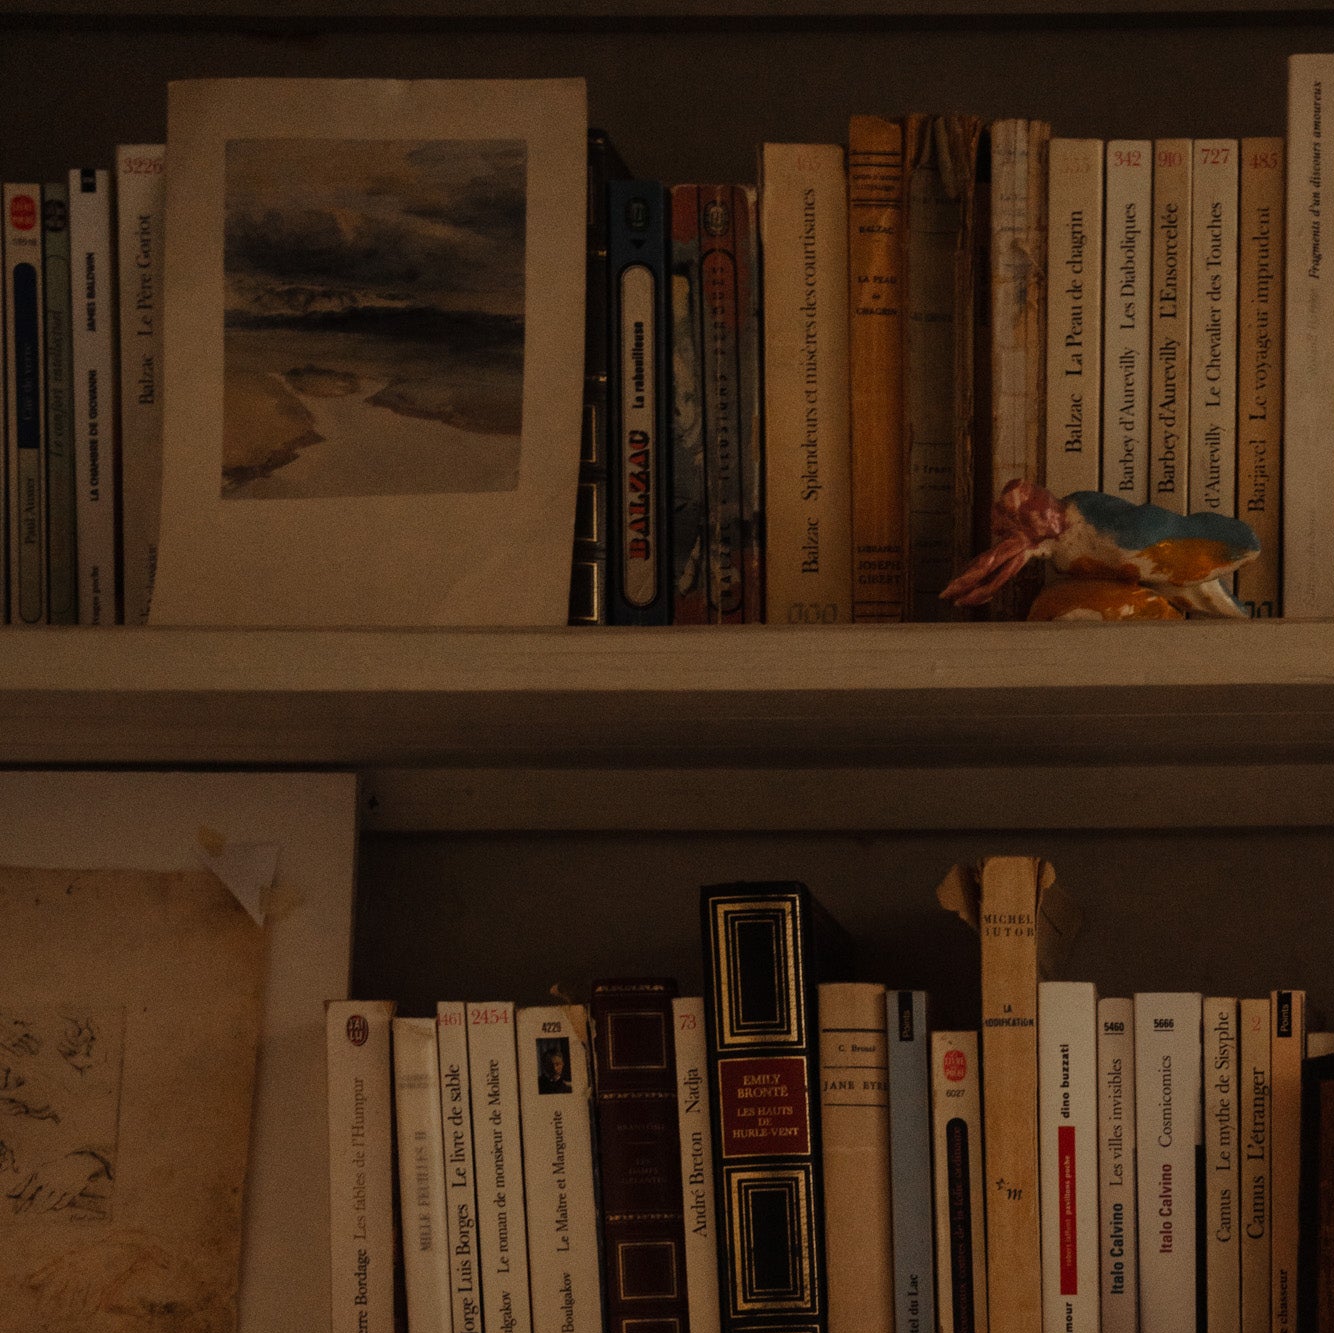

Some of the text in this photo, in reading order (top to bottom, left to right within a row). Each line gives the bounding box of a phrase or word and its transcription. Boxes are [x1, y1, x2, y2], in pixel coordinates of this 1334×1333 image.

[1119, 203, 1140, 297] Diaboliques
[136, 215, 154, 405] Balzac Le Père Goriot
[1120, 302, 1136, 329] Les
[1065, 210, 1088, 453] Balzac La Peau de chagrin
[800, 189, 819, 574] Balzac Splendeurs et misères des courtisanes
[627, 321, 650, 560] BALZAC La rabouilleuse
[1119, 435, 1140, 491] Barbey
[471, 1010, 508, 1025] 2454
[446, 1064, 462, 1103] sable
[487, 1060, 502, 1106] Molière
[743, 1073, 781, 1086] EMILY
[448, 1107, 463, 1126] de
[490, 1110, 503, 1126] de
[1157, 1055, 1172, 1148] Cosmicomics
[450, 1131, 466, 1164] livre
[492, 1130, 506, 1189] monsieur
[551, 1111, 569, 1175] Marguerite
[452, 1169, 467, 1188] Le
[555, 1179, 566, 1189] et
[1108, 1059, 1124, 1294] Italo Calvino Les villes invisibles
[1158, 1164, 1172, 1217] Calvino
[494, 1192, 507, 1208] de
[553, 1193, 569, 1230] Maître
[454, 1204, 476, 1255] Borges
[498, 1213, 509, 1253] roman
[556, 1234, 570, 1252] Le
[1158, 1221, 1172, 1253] Italo
[458, 1260, 473, 1293] Luis
[496, 1256, 510, 1273] Le
[559, 1272, 577, 1333] Boulgakov
